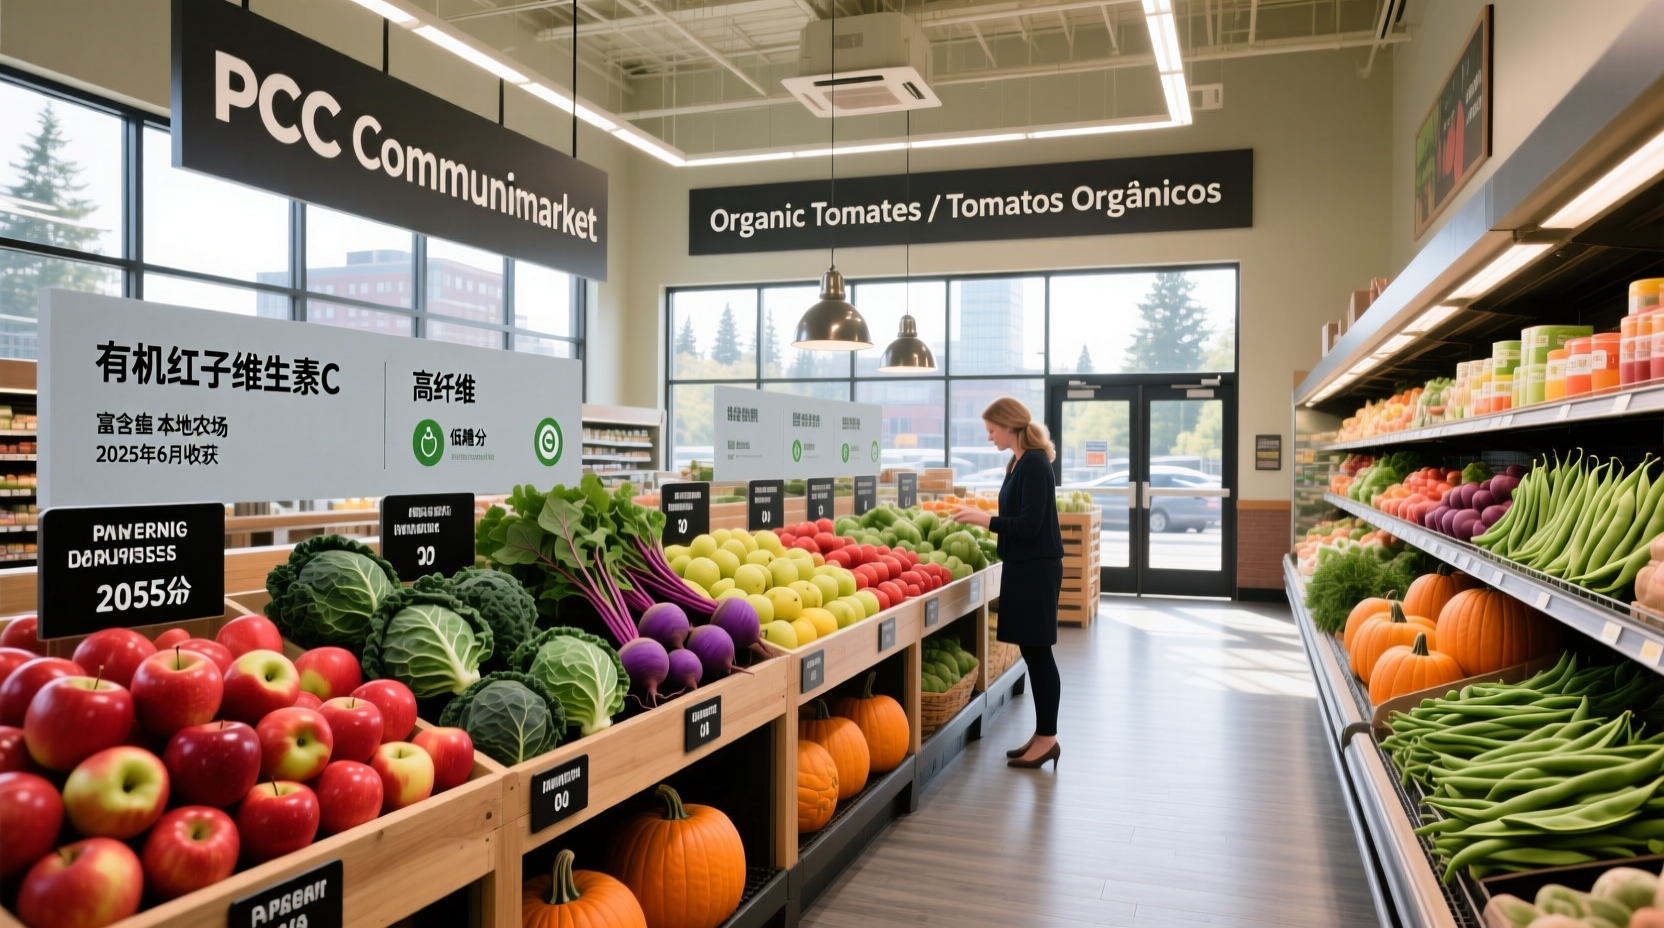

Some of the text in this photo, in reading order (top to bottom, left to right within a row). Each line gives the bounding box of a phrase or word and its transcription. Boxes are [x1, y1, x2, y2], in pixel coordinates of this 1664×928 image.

[214, 49, 343, 160] PCC
[709, 178, 1222, 238] Organic Tomates / Tomatos Orgânicos
[95, 339, 341, 401] 有机红子维生素C
[412, 369, 477, 405] 高纤维
[157, 412, 229, 439] 本地农场
[95, 443, 219, 466] 2025年6月收获
